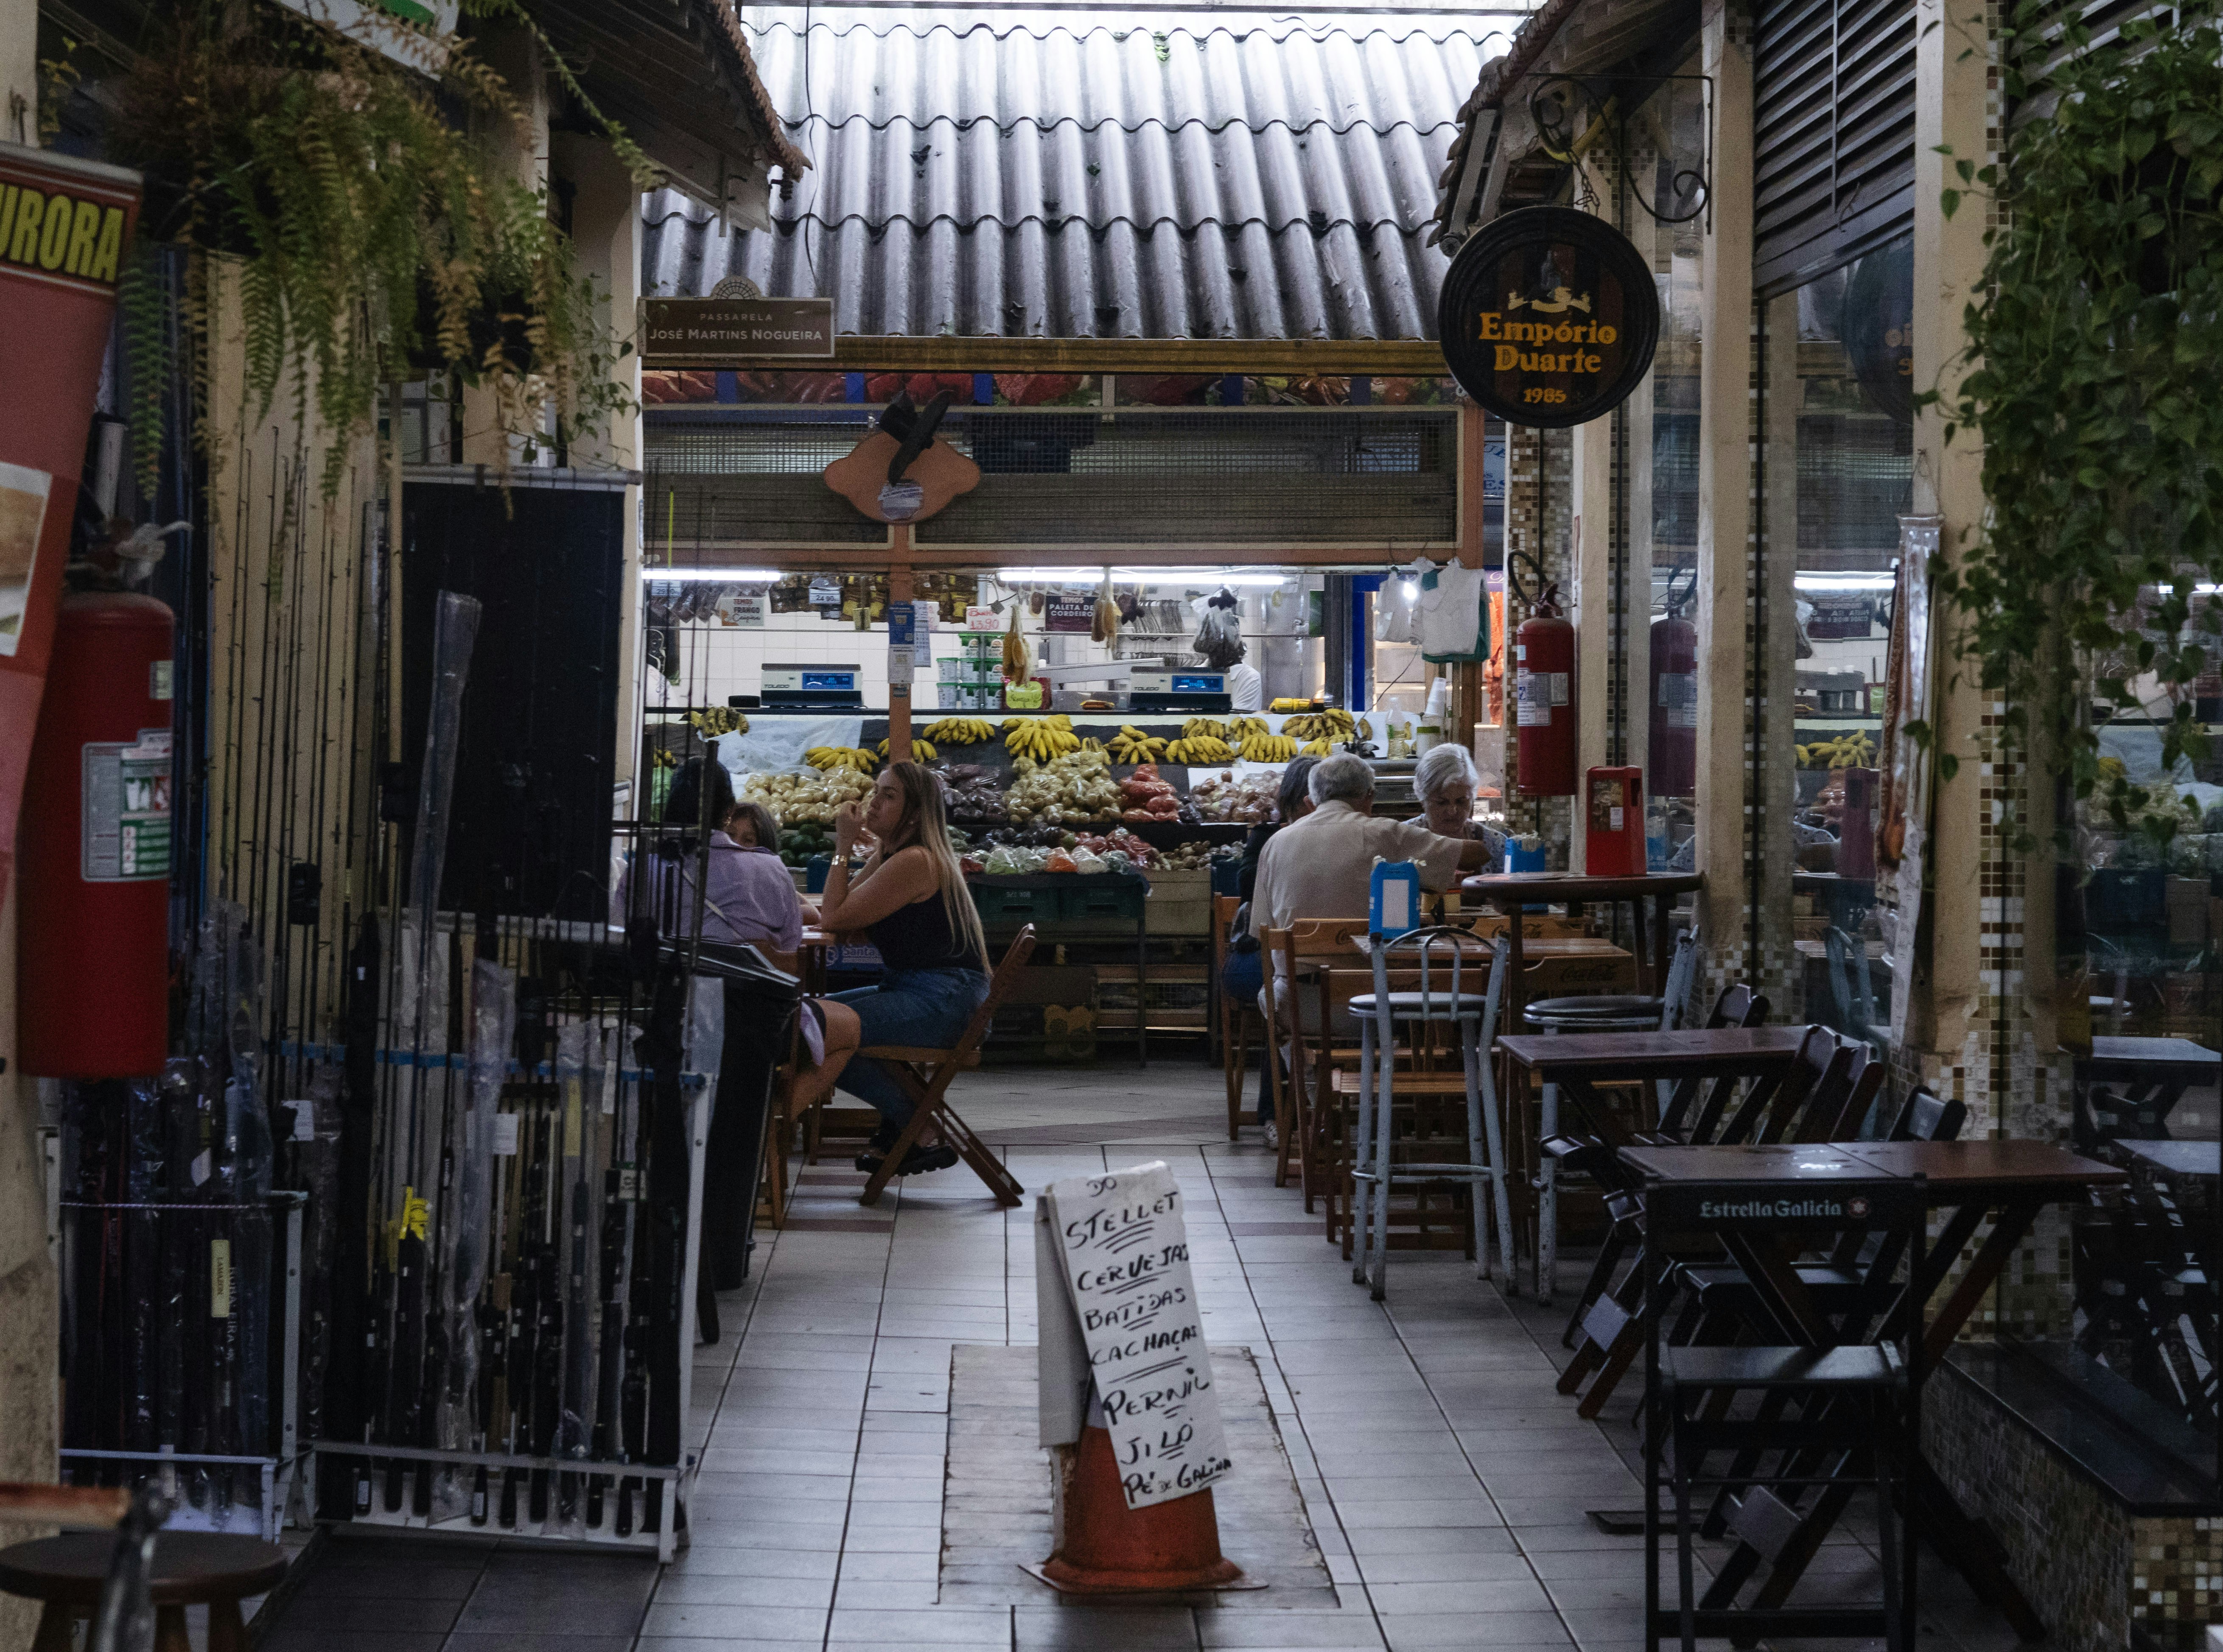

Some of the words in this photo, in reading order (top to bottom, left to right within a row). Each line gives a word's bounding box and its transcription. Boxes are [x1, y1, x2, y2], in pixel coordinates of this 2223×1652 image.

[700, 313, 773, 321] PASSARELA
[1478, 312, 1617, 347] Empório
[1494, 345, 1602, 373] Duarte
[1523, 387, 1568, 404] 1985
[1699, 1201, 1772, 1218] Estrella
[1774, 1199, 1842, 1217] Galicia
